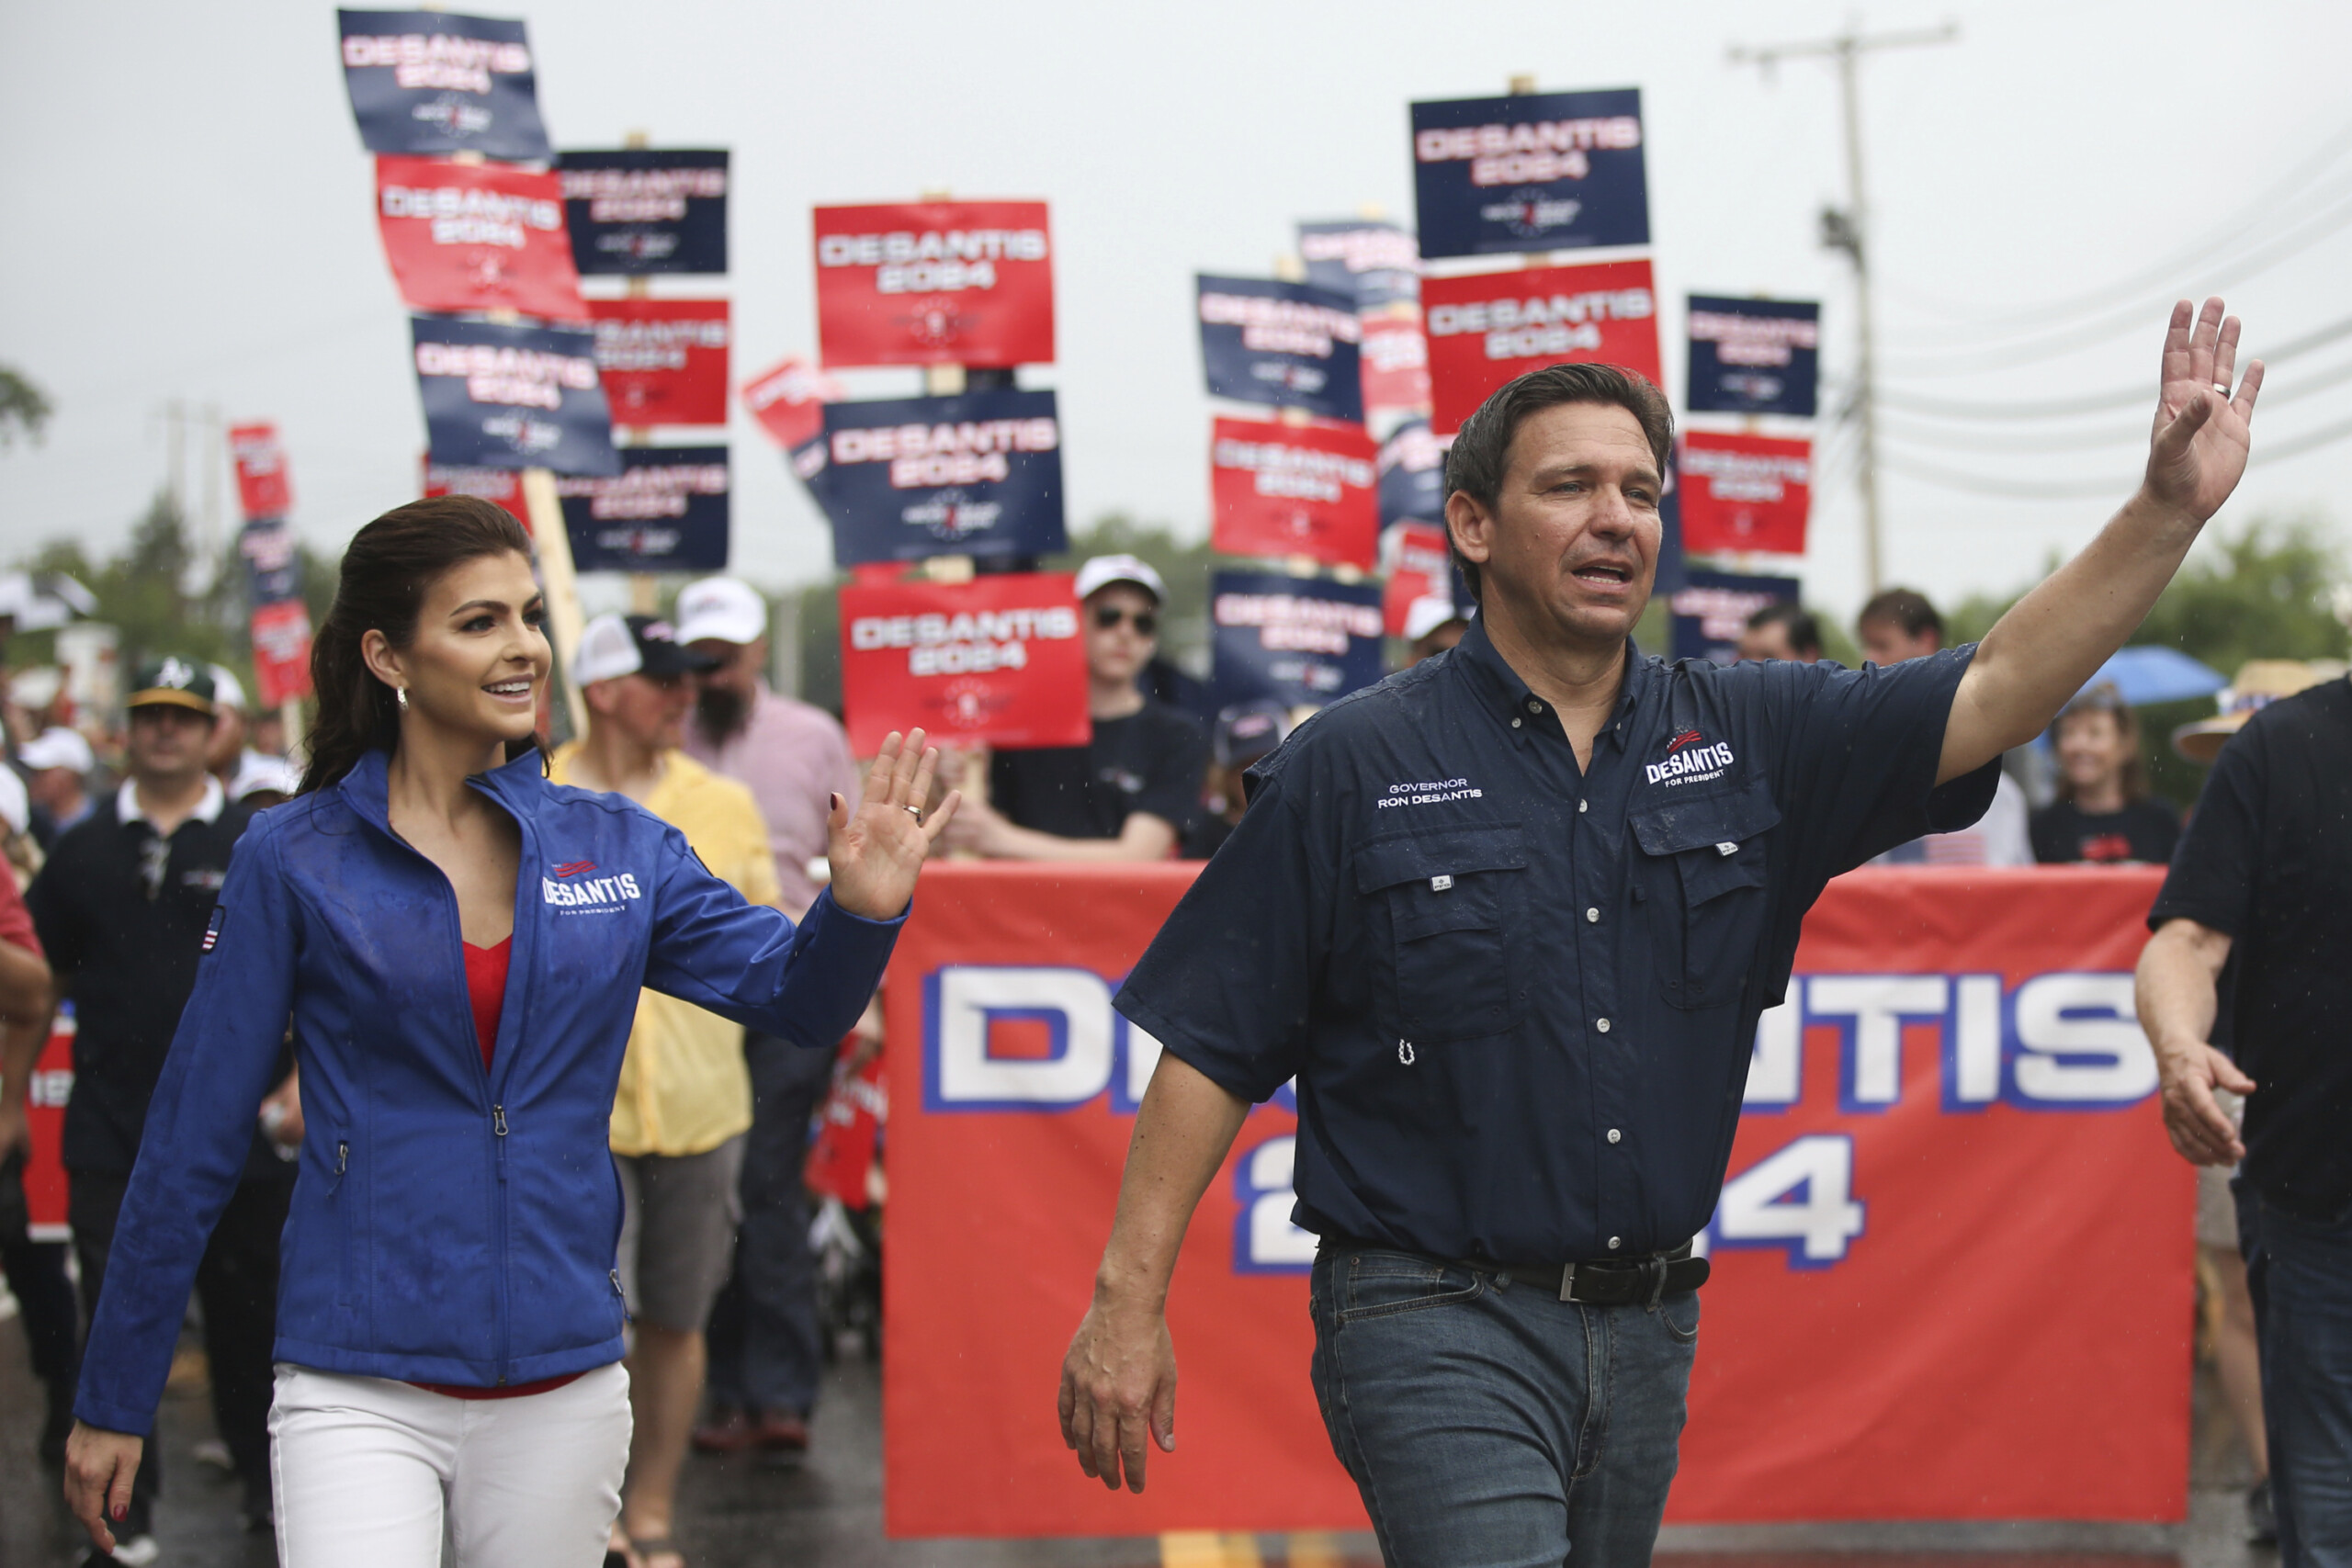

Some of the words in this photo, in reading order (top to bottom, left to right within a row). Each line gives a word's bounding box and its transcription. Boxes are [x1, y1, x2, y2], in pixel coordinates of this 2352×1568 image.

[1417, 116, 1641, 162] DESANTIS
[382, 186, 561, 231] DESANTIS
[819, 230, 1046, 266] DESANTIS
[876, 261, 996, 293] 2024
[1427, 288, 1653, 337] DESANTIS
[1485, 323, 1600, 360] 2024
[831, 418, 1057, 464] DESANTIS
[890, 454, 1007, 489] 2024
[851, 607, 1078, 649] DESANTIS
[909, 642, 1026, 676] 2024
[1645, 741, 1735, 784] DESANTIS
[1665, 779, 1683, 788] FOR
[1684, 769, 1724, 784] PRESIDENT
[1378, 796, 1408, 808] RON
[1412, 789, 1483, 805] DESANTIS
[1389, 778, 1467, 794] GOVERNOR
[542, 873, 641, 906] DESANTIS
[579, 905, 626, 916] PRESIDENT
[923, 964, 2161, 1114] DTIS
